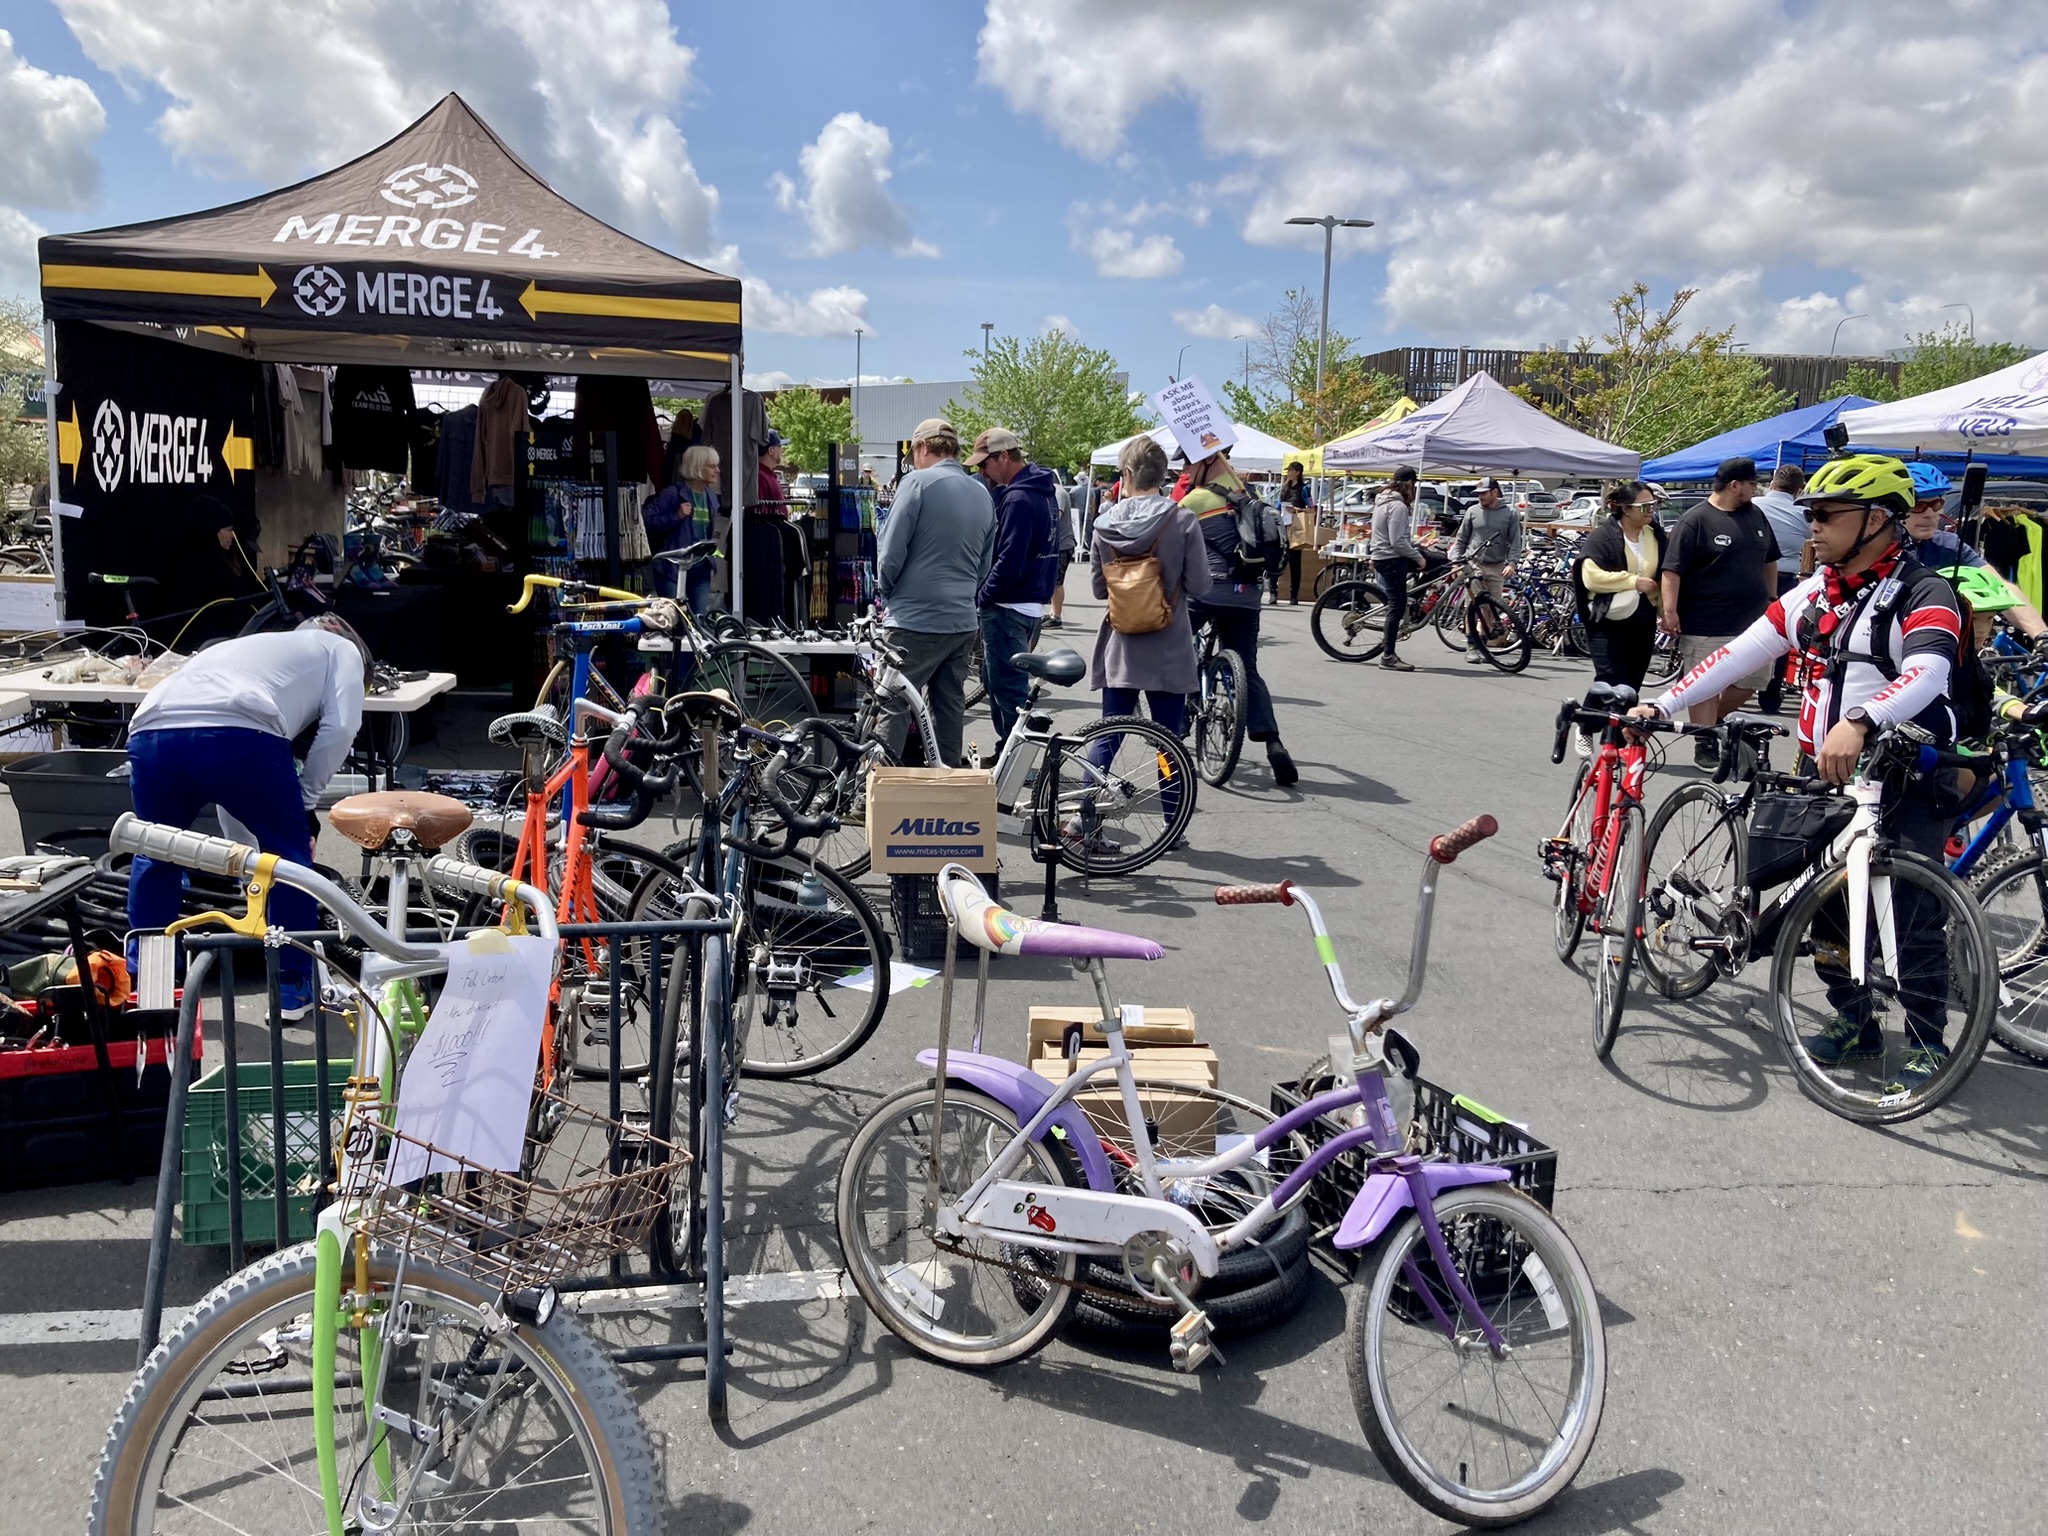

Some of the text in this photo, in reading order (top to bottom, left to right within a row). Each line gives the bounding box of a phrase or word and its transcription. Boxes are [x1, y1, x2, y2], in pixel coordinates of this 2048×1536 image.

[1162, 381, 1195, 402] ASK ME
[1171, 391, 1195, 407] about
[352, 401, 368, 409] TEAM
[1173, 398, 1201, 414] Napa's
[1173, 403, 1212, 425] mountain
[1183, 413, 1211, 429] biking
[1190, 422, 1213, 435] team
[1958, 418, 2018, 438] VELO
[1671, 645, 1731, 698] KENDA
[1870, 666, 1927, 704] KEND
[890, 818, 980, 836] Mitas
[894, 847, 977, 856] www.mitas-tyres.com
